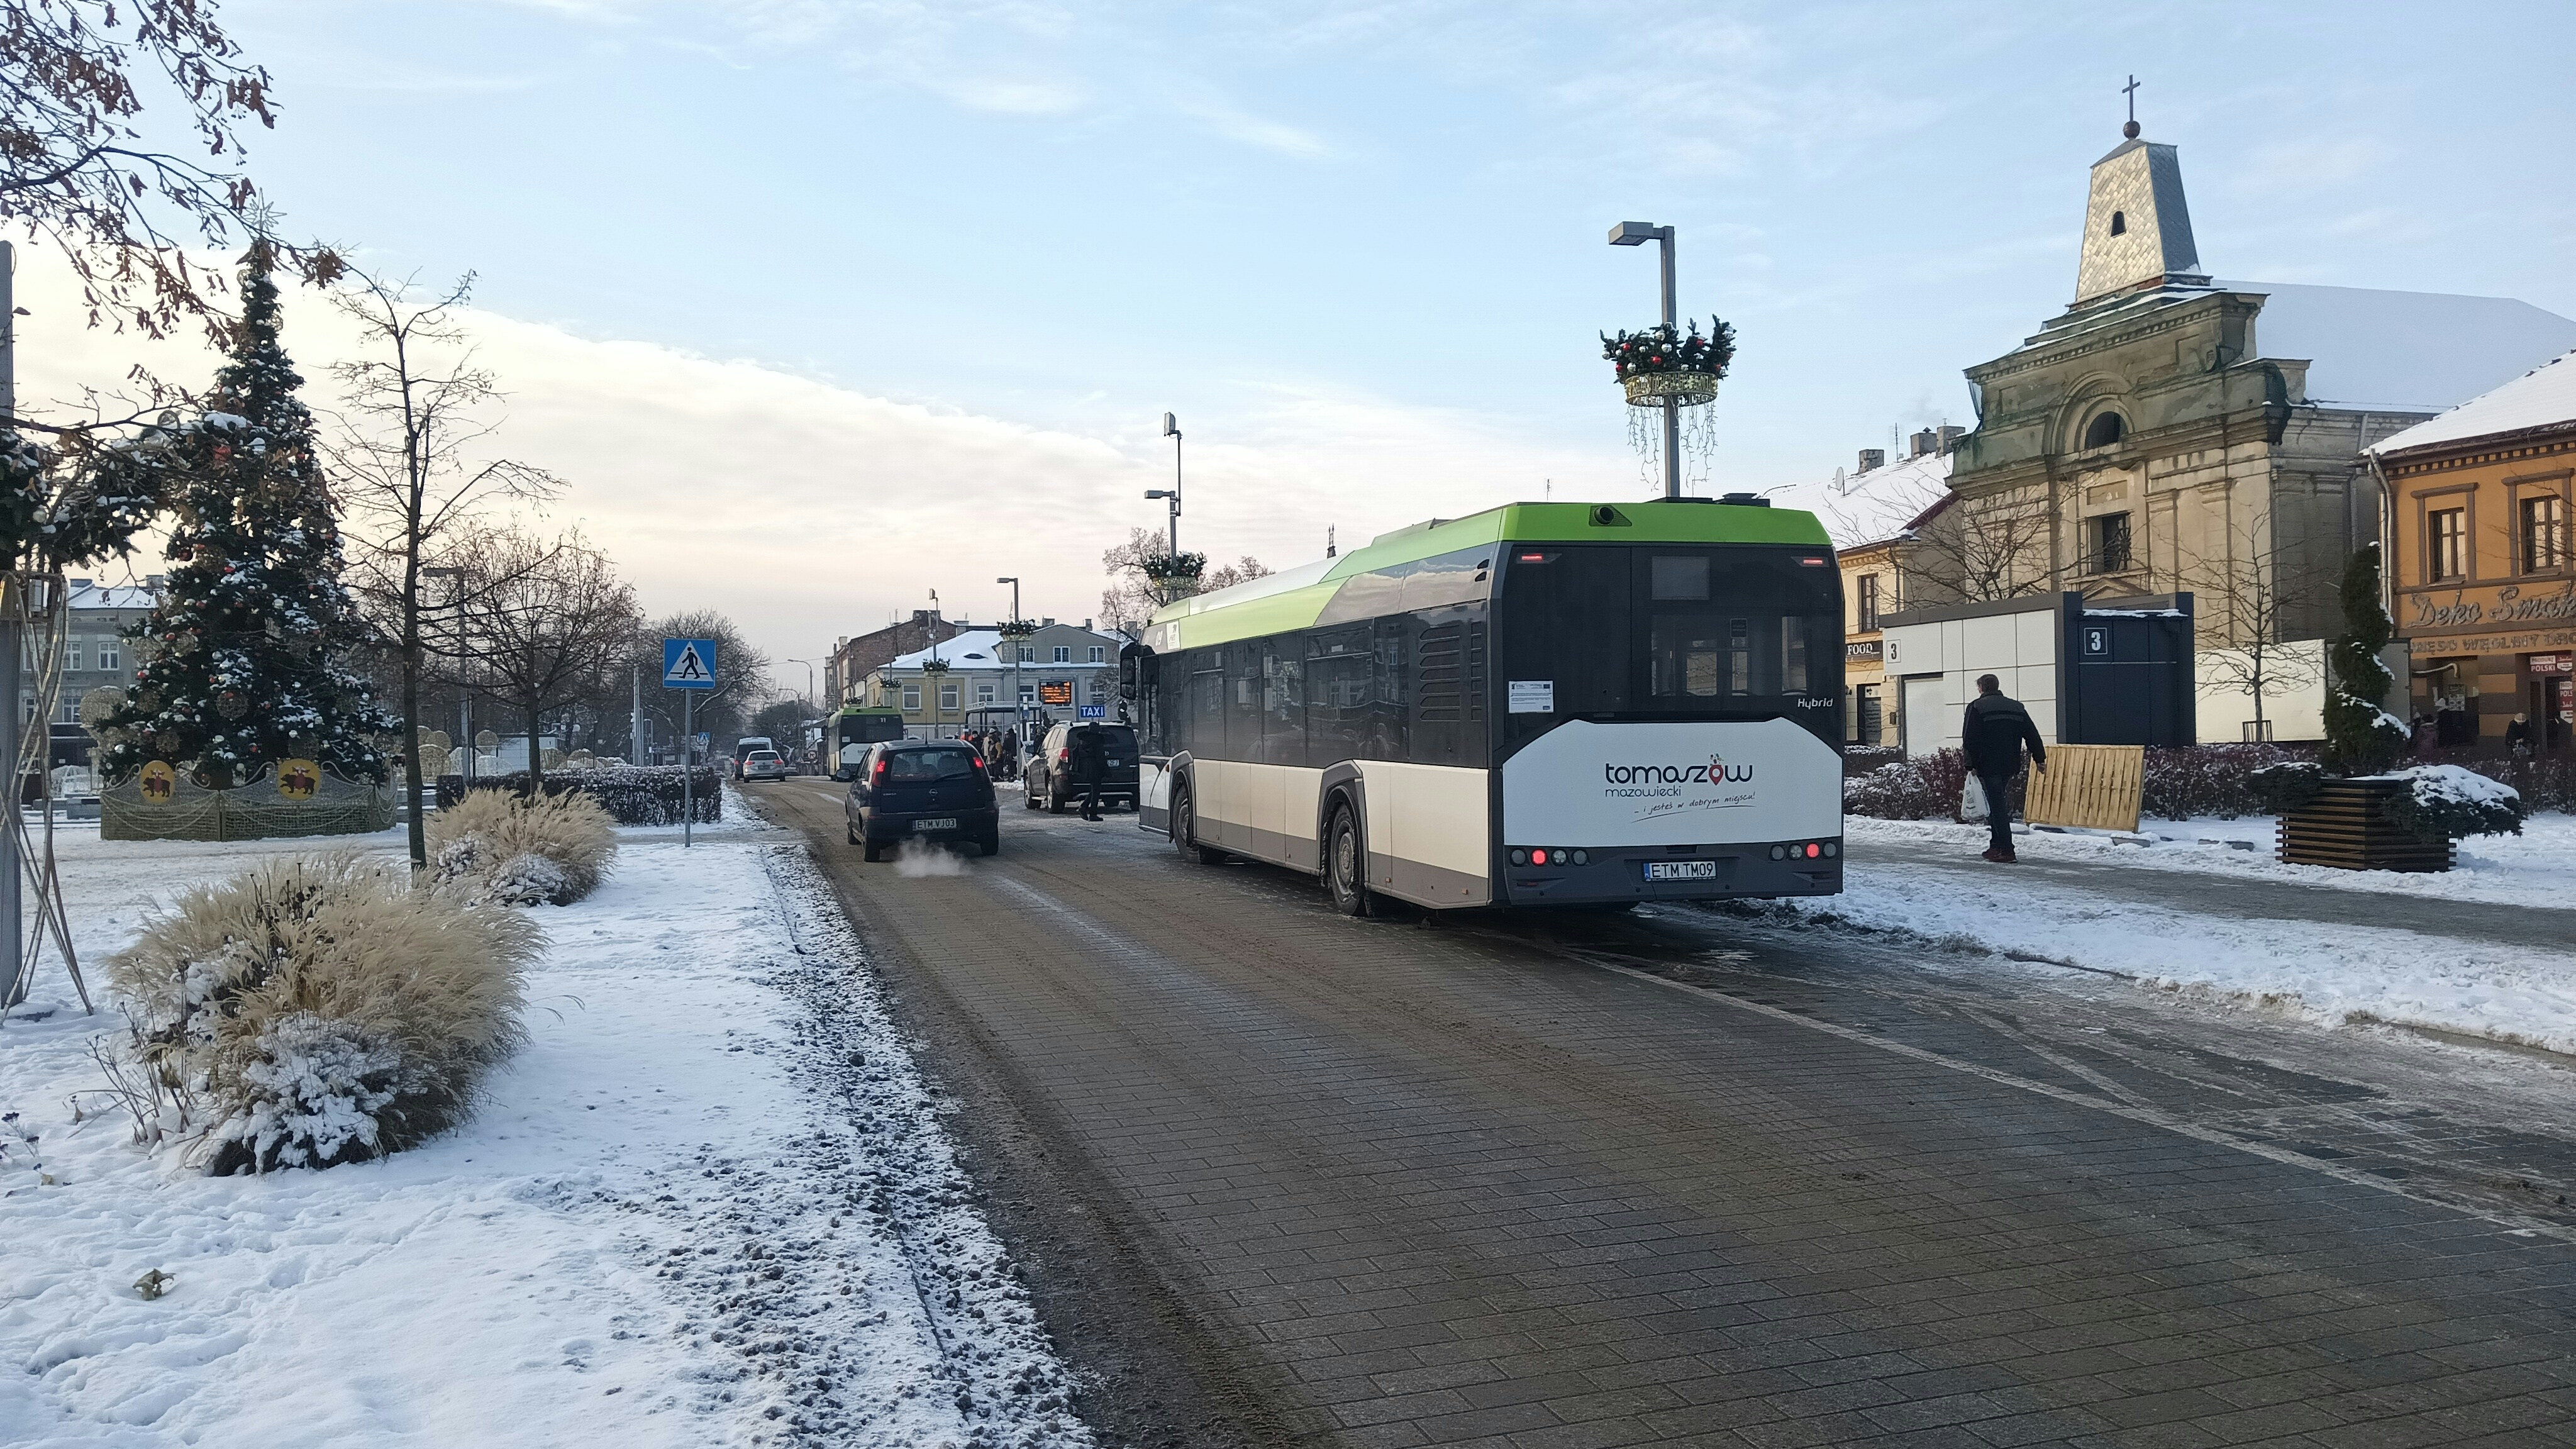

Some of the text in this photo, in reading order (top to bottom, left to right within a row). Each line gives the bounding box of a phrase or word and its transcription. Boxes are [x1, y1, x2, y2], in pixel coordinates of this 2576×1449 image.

[2091, 631, 2101, 651] 3
[1847, 643, 1873, 655] FOOD
[1890, 643, 1897, 660] 3
[1797, 698, 1833, 709] Hybrid
[1082, 707, 1103, 716] TAXI
[1606, 786, 1681, 797] mazowiecki
[1648, 801, 1673, 814] jesteś
[1689, 798, 1719, 809] dobrym
[1724, 791, 1755, 805] miejscu!
[917, 819, 955, 829] ETM VJ03
[1652, 863, 1679, 877] ETM
[1683, 862, 1713, 877] TM09
